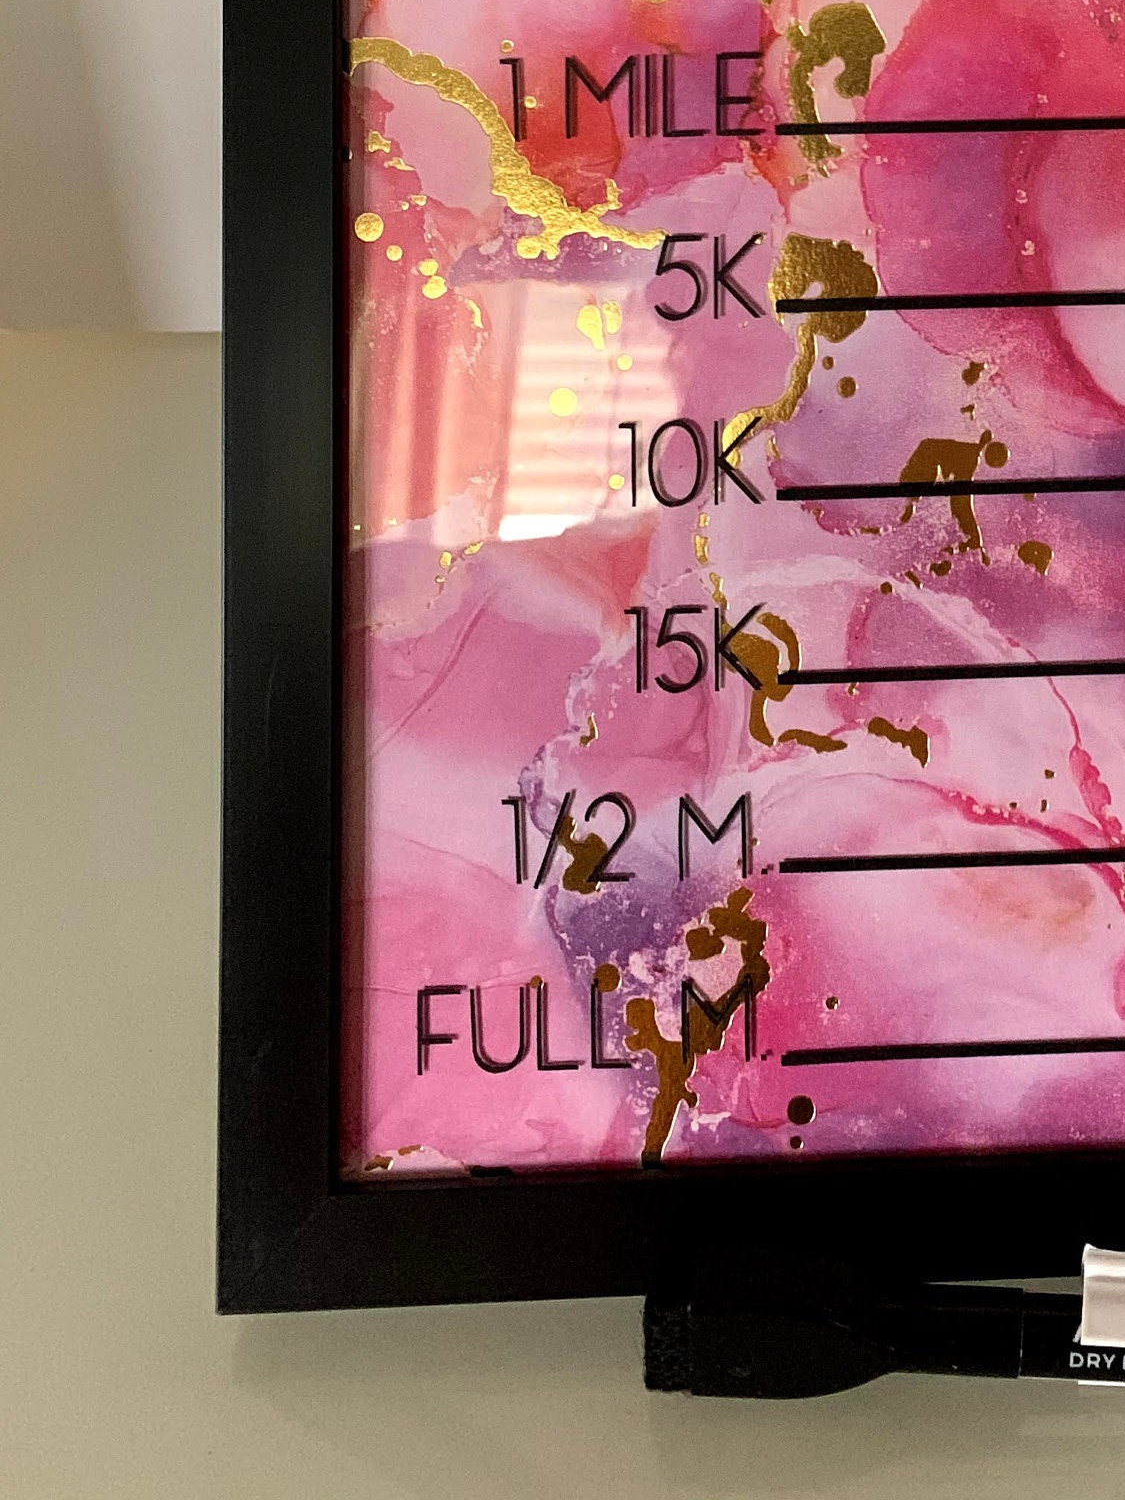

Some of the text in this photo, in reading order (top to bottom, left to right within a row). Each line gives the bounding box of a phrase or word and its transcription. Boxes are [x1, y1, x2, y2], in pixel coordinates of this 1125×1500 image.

[500, 52, 764, 141] 1 MILE
[654, 233, 766, 321] 5K
[619, 417, 764, 507] 10K
[624, 603, 766, 693] 15K
[502, 789, 773, 888] 1/2 M.
[417, 982, 638, 1075] FULL
[1069, 1352, 1116, 1370] DRY
